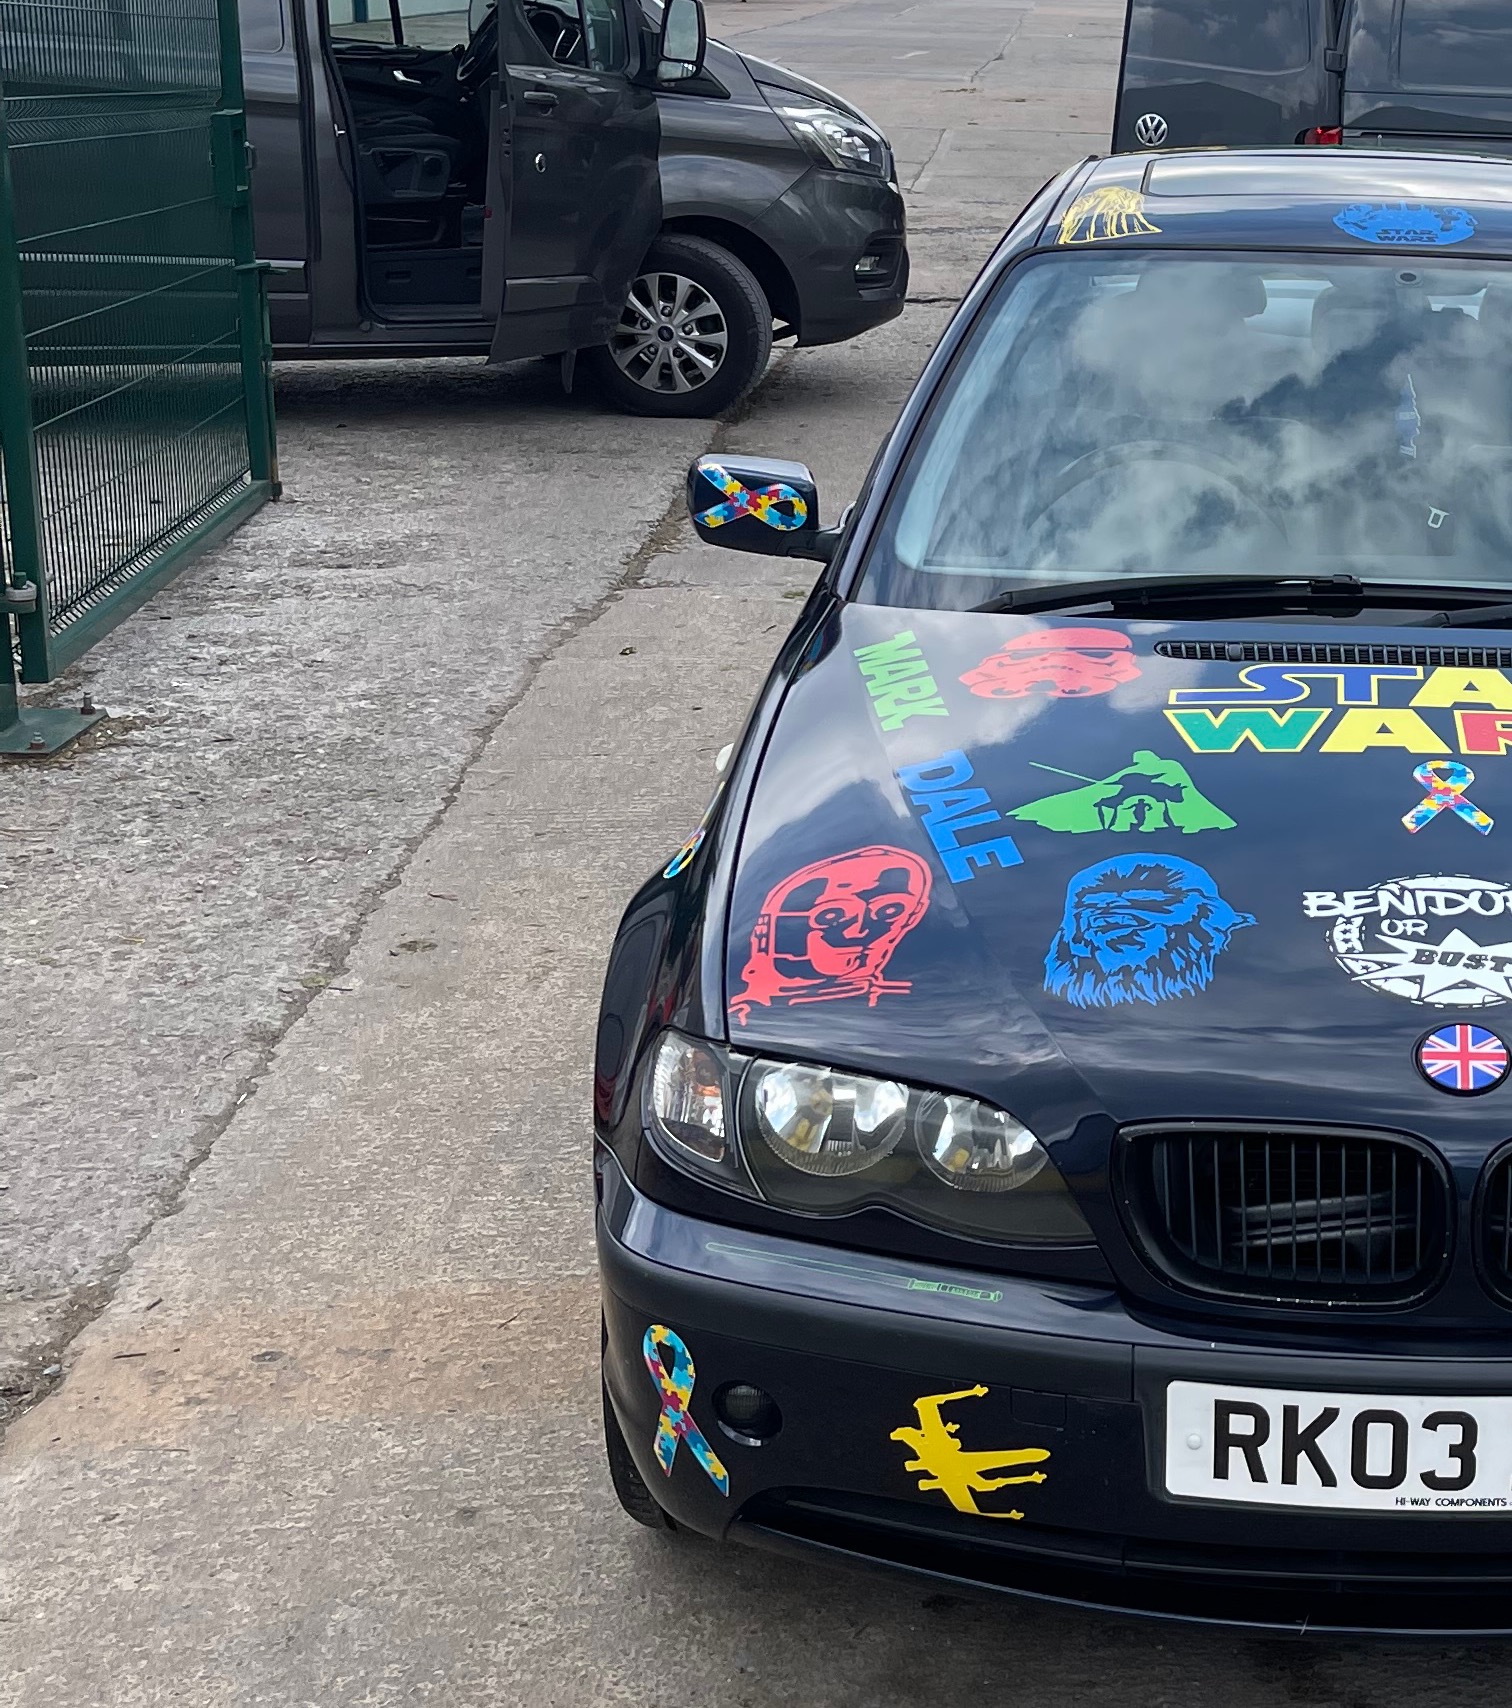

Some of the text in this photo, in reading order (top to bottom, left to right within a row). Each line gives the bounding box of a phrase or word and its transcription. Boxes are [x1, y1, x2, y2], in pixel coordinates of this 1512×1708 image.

[1376, 229, 1438, 237] STAR
[1377, 235, 1438, 243] WARS
[853, 630, 949, 732] MARK
[897, 749, 1024, 884] DALE
[1381, 918, 1429, 936] OR
[1213, 1398, 1479, 1492] RK03
[1395, 1497, 1431, 1506] HI-WAY
[1435, 1497, 1507, 1507] COMPONENTS
